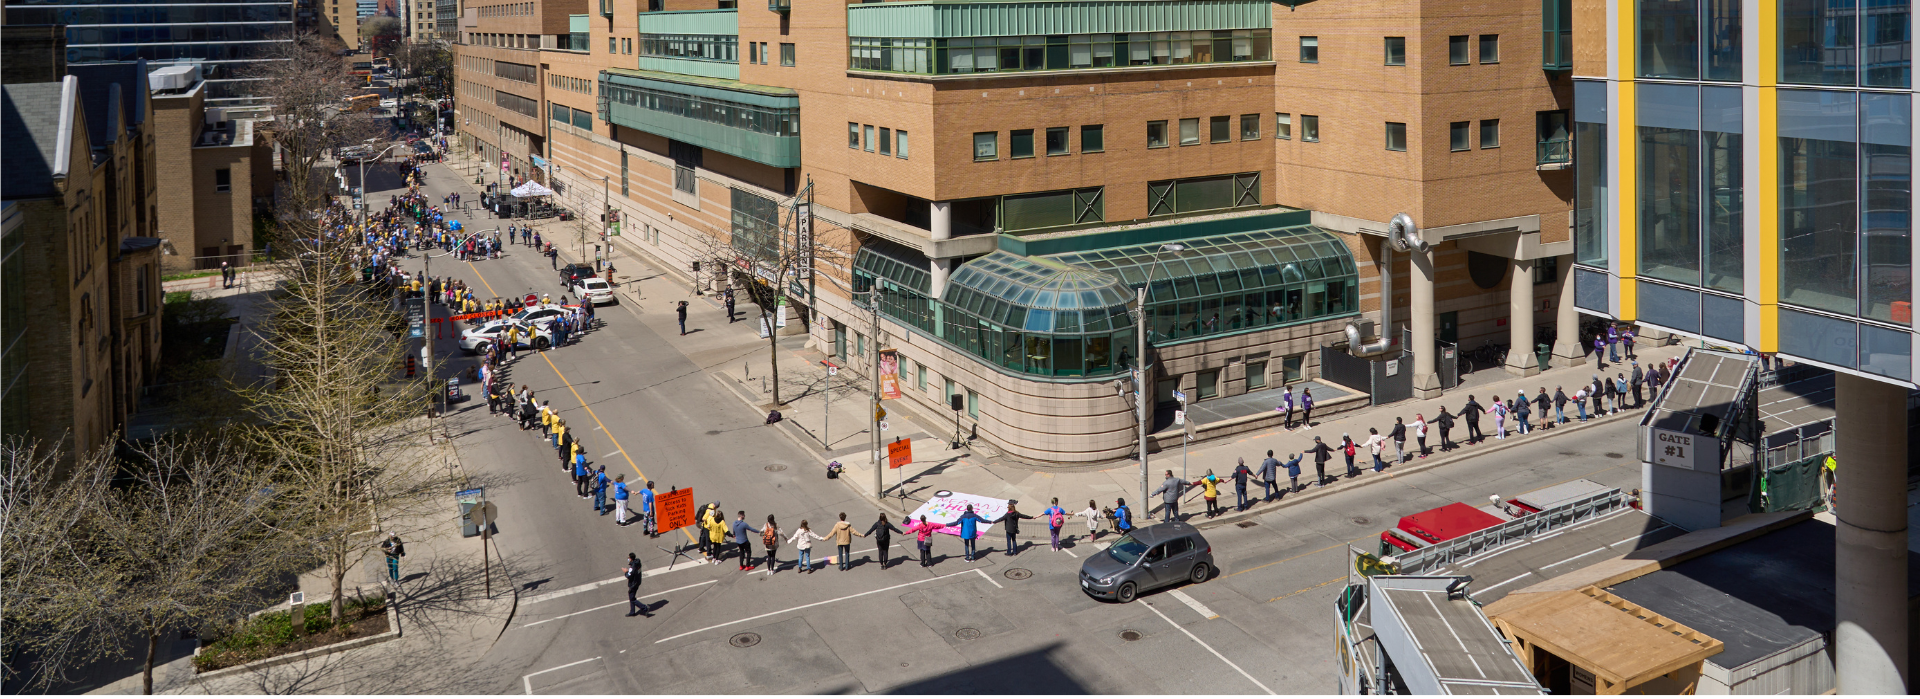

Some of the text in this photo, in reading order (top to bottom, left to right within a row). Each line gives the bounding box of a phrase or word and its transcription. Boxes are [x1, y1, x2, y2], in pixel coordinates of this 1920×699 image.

[470, 311, 494, 319] CLOSED
[1659, 433, 1691, 446] GATE
[890, 444, 910, 455] SPECIAL
[1664, 445, 1685, 459] #1
[893, 455, 909, 465] EVENT
[669, 518, 688, 529] ONLY
